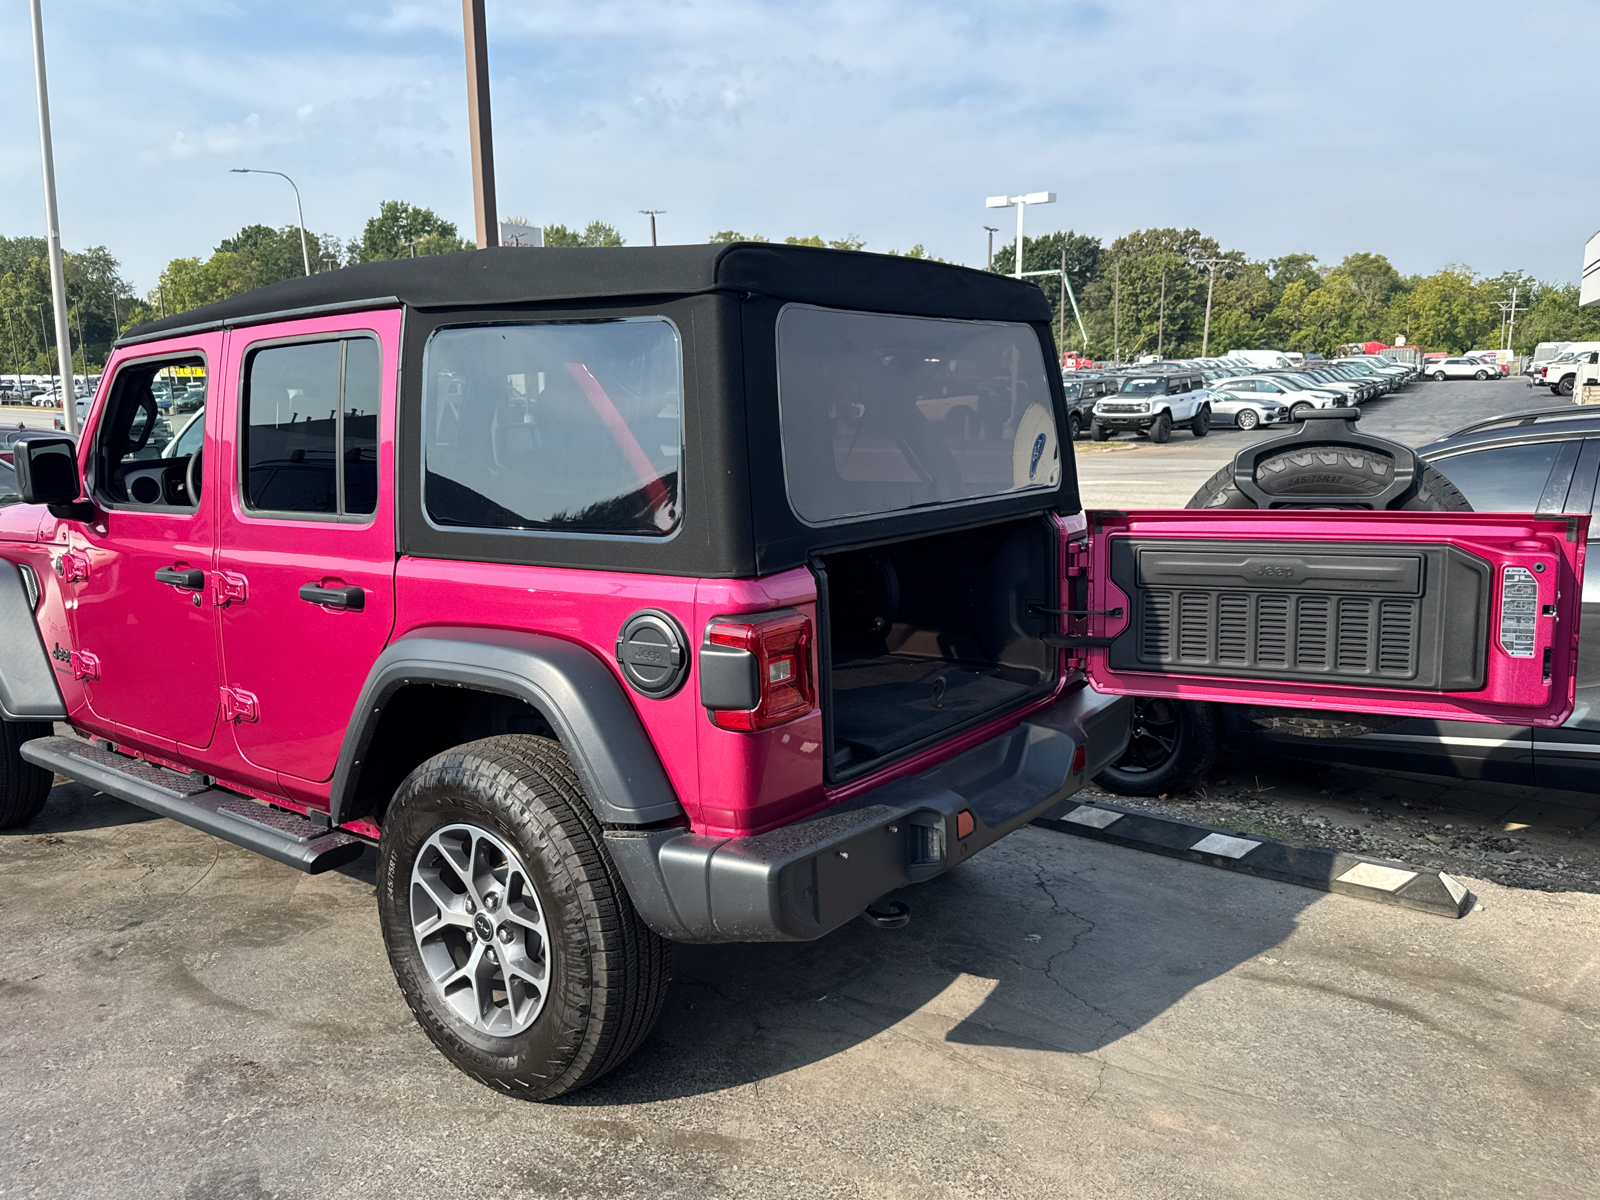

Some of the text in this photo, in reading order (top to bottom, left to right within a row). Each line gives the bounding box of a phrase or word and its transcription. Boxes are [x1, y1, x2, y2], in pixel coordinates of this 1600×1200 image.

[1287, 475, 1344, 486] 245/75R17
[1254, 563, 1294, 579] Jeep
[635, 645, 661, 663] Jeep
[387, 849, 398, 901] 245/75R17
